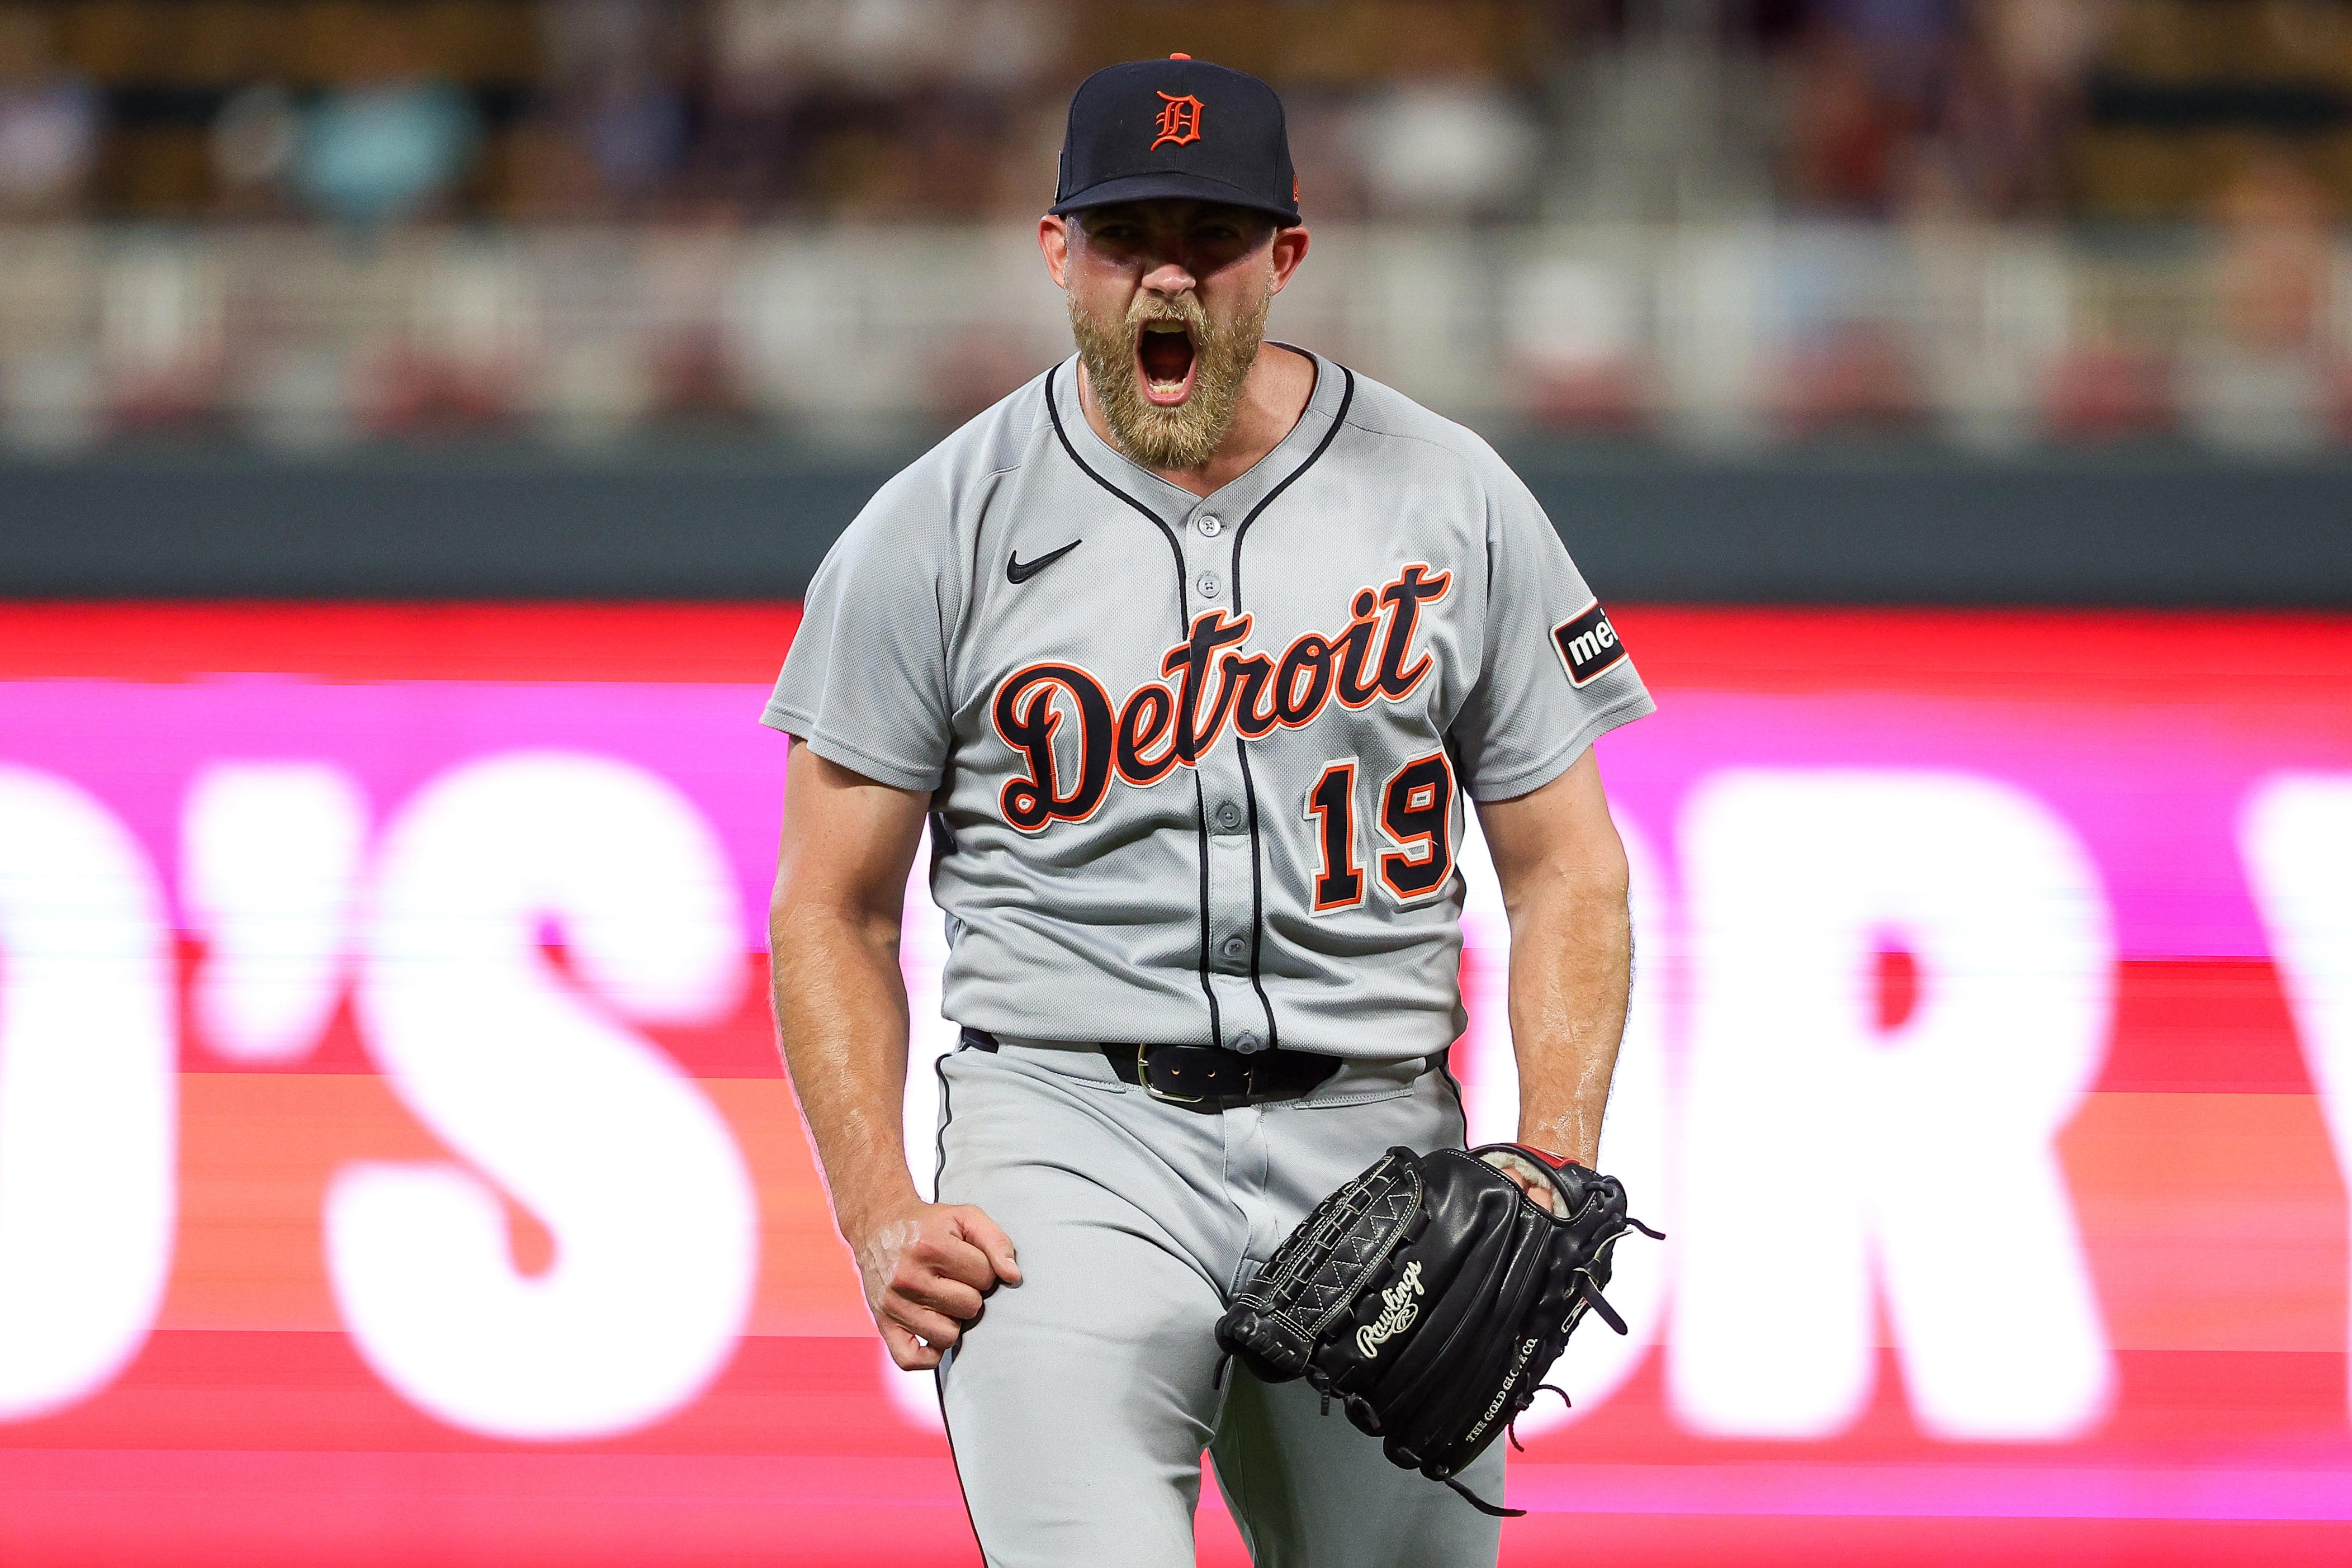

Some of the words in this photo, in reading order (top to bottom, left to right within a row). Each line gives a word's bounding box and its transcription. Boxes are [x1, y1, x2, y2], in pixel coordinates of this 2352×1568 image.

[1151, 91, 1205, 151] D
[992, 560, 1453, 835] Detroit
[1303, 747, 1457, 917] 19
[1356, 1261, 1425, 1359] Rawlings
[1465, 1420, 1487, 1443] THE
[1484, 1390, 1506, 1422] GOLD
[1522, 1338, 1538, 1356] CO.
